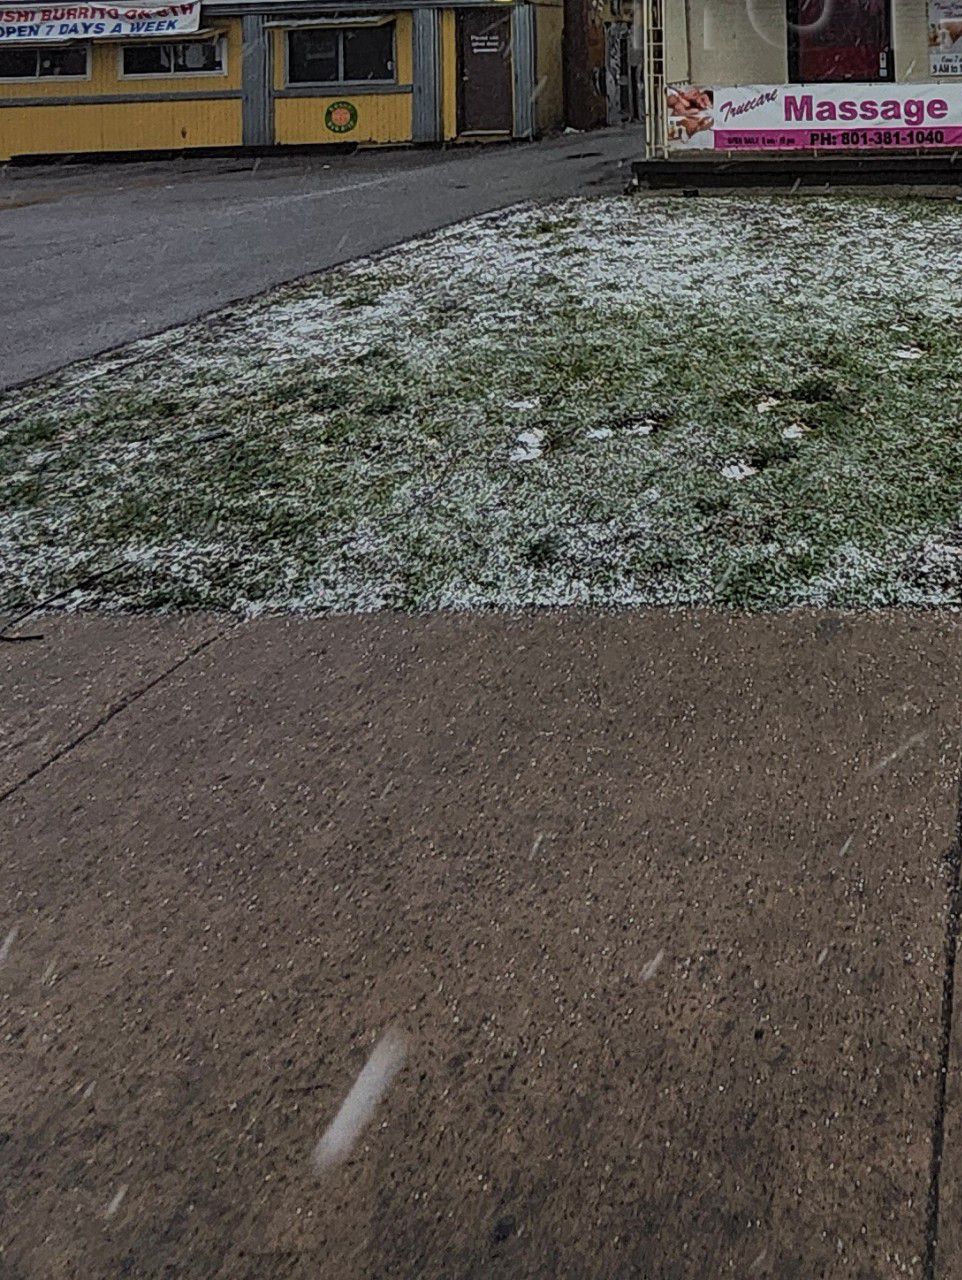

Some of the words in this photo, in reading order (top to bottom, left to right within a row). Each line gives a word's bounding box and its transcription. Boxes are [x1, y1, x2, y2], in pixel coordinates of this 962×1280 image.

[41, 7, 119, 22] BURRITO
[46, 25, 54, 36] 7
[58, 23, 105, 35] DAYS
[110, 23, 122, 33] A
[130, 20, 178, 33] WEEK
[784, 94, 949, 126] Massage
[809, 133, 838, 146] PH:
[841, 130, 944, 145] 801-381-1040
